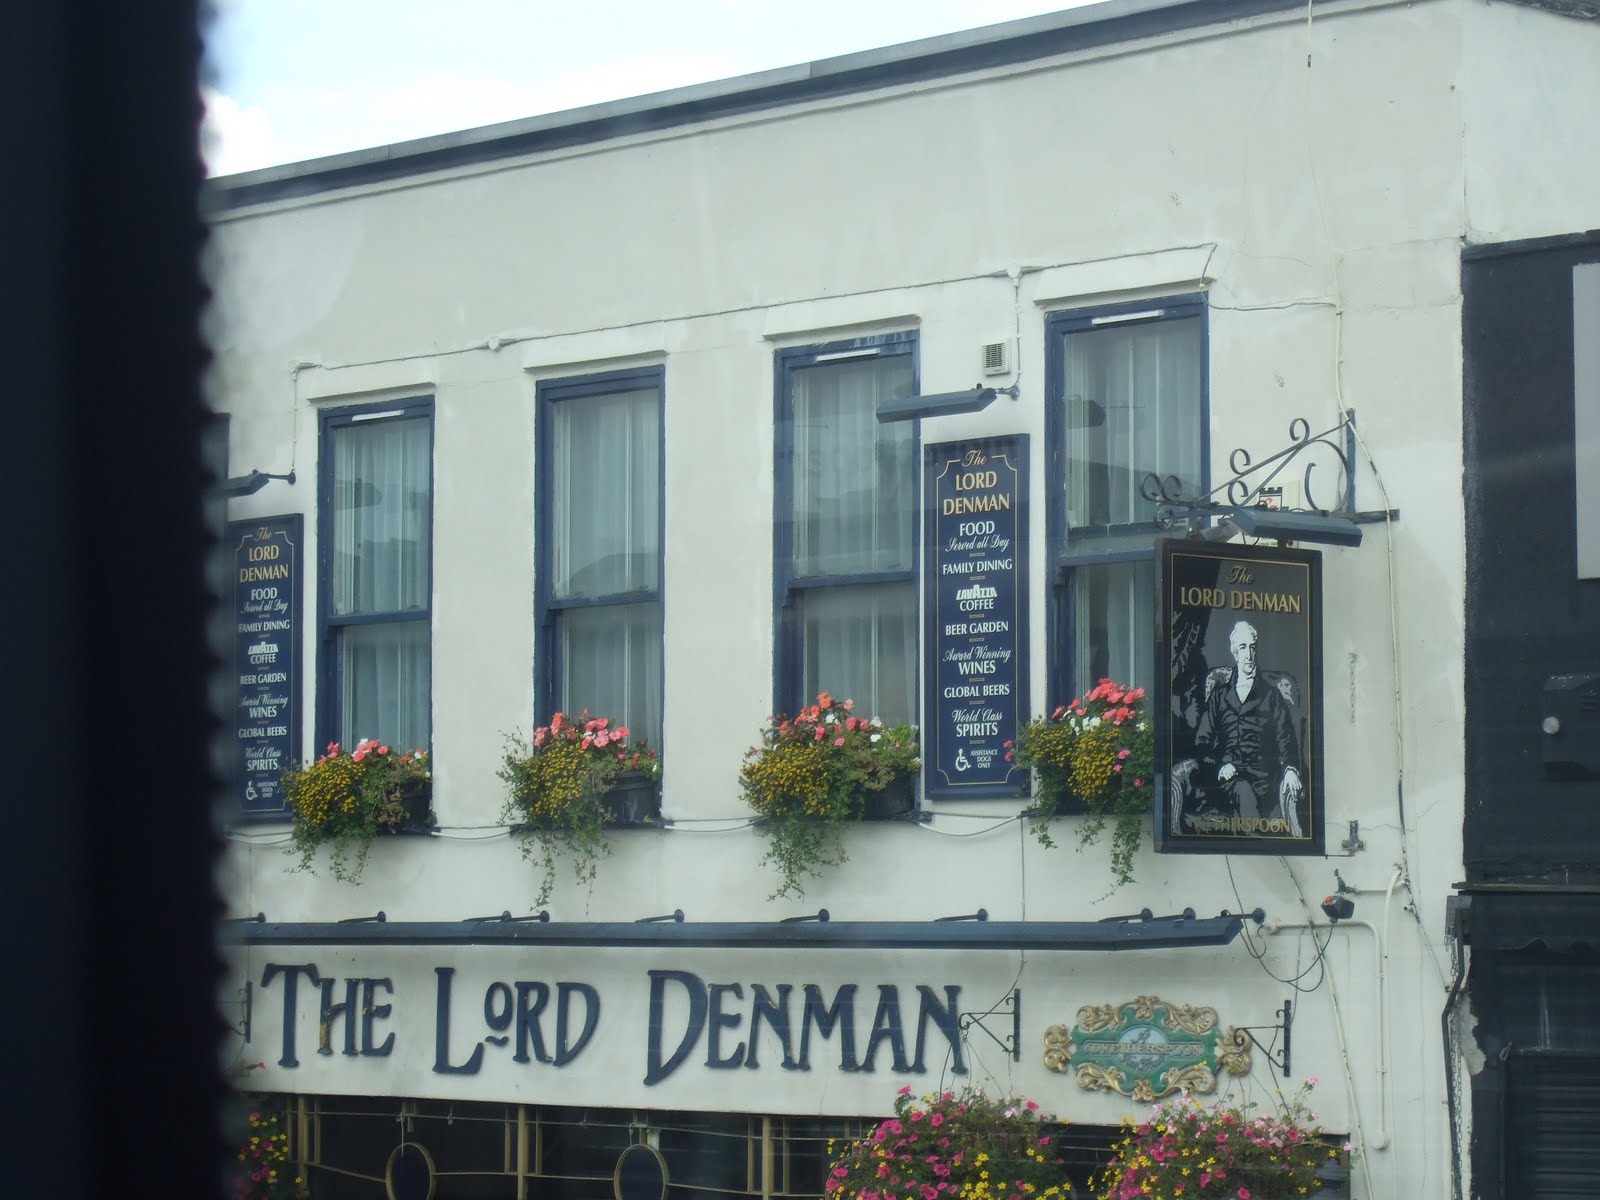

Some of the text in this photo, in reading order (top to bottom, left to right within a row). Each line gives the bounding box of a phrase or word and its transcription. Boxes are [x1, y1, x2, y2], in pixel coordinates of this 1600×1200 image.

[962, 450, 987, 467] The
[956, 471, 997, 491] LORD
[943, 493, 1010, 516] DENMAN
[254, 527, 272, 542] The
[959, 520, 995, 537] FOOD
[945, 534, 1010, 552] Served all Day
[249, 545, 279, 562] LORD
[240, 564, 289, 583] DENMAN
[942, 558, 1013, 575] FAMILY DINING
[1226, 565, 1254, 584] The
[251, 587, 278, 601] FOOD
[956, 584, 998, 601] LAVAZZA
[1181, 586, 1301, 614] LORD DENMAN
[959, 599, 994, 612] COFFEE
[238, 619, 290, 633] FAMILY DINING
[945, 621, 1009, 636] BEER GARDEN
[250, 653, 276, 665] COFFEE
[942, 645, 1012, 663] Award Winning
[958, 660, 996, 675] WINES
[240, 672, 287, 685] BEER GARDEN
[944, 684, 1010, 699] GLOBAL BEERS
[249, 706, 277, 718] WINES
[951, 707, 1003, 723] World Class
[238, 726, 287, 738] GLOBAL BEERS
[956, 722, 998, 738] SPIRITS
[246, 758, 278, 771] SPIRITS
[261, 962, 968, 1086] THE LORD DENMAN
